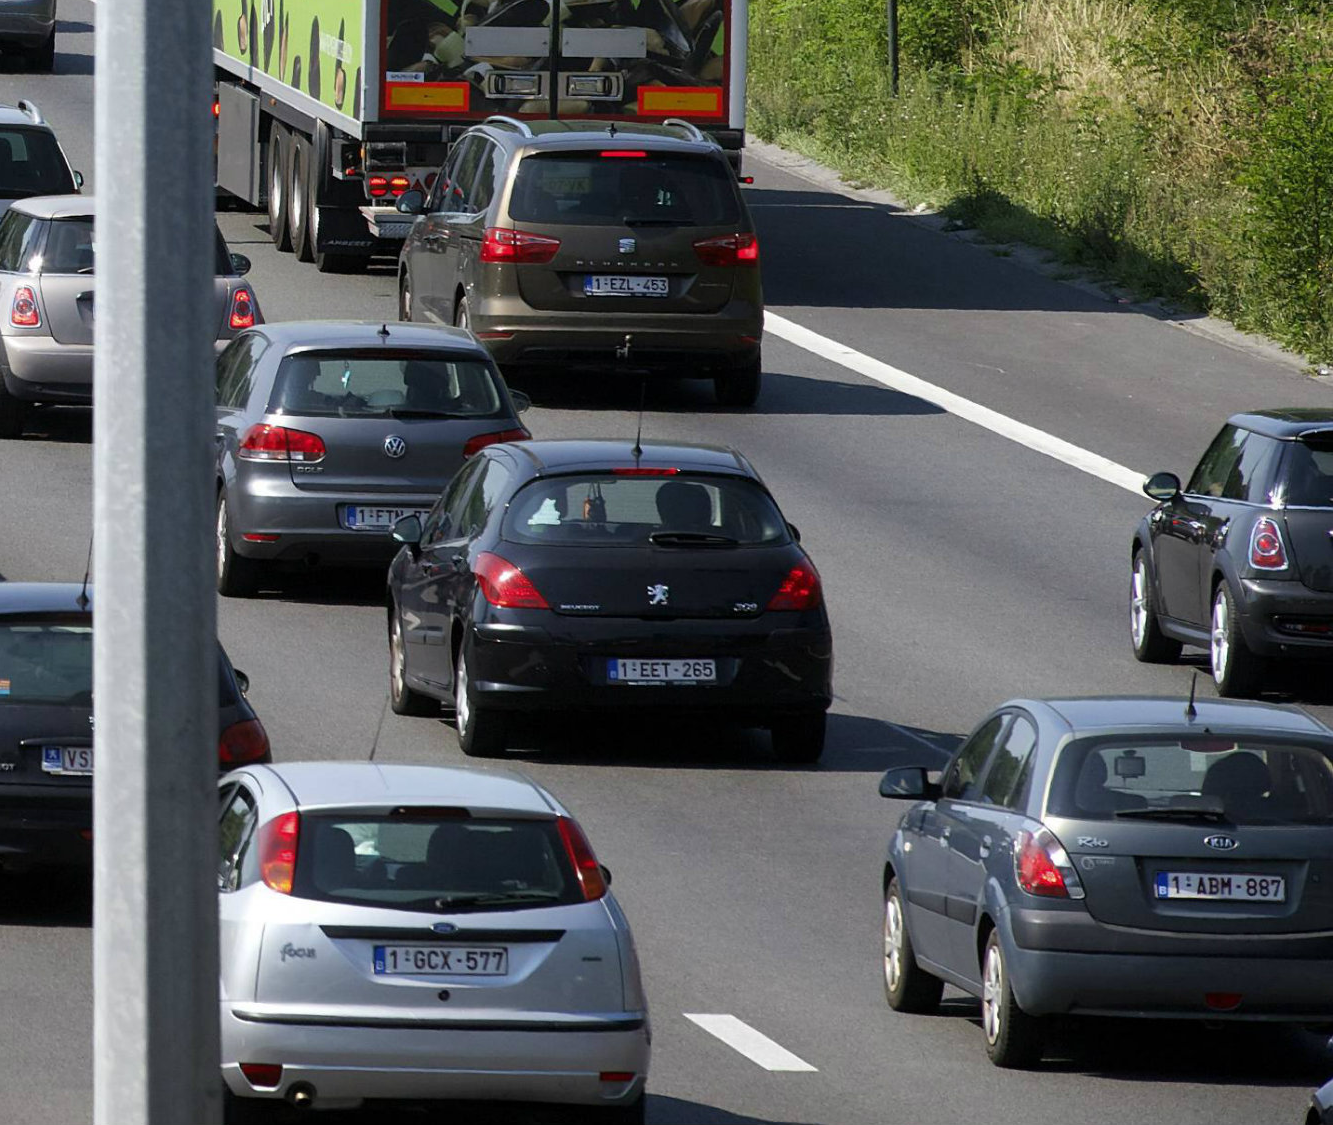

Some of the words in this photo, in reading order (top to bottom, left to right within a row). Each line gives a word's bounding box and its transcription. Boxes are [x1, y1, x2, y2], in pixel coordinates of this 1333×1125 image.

[595, 278, 667, 291] 1-EZL-453
[621, 662, 714, 678] 1-EET-265
[67, 750, 93, 768] VS
[1077, 836, 1109, 848] Rio
[1210, 838, 1233, 848] KIA
[1171, 875, 1282, 899] 1-ABM-887
[388, 949, 505, 972] 1-GCX-577
